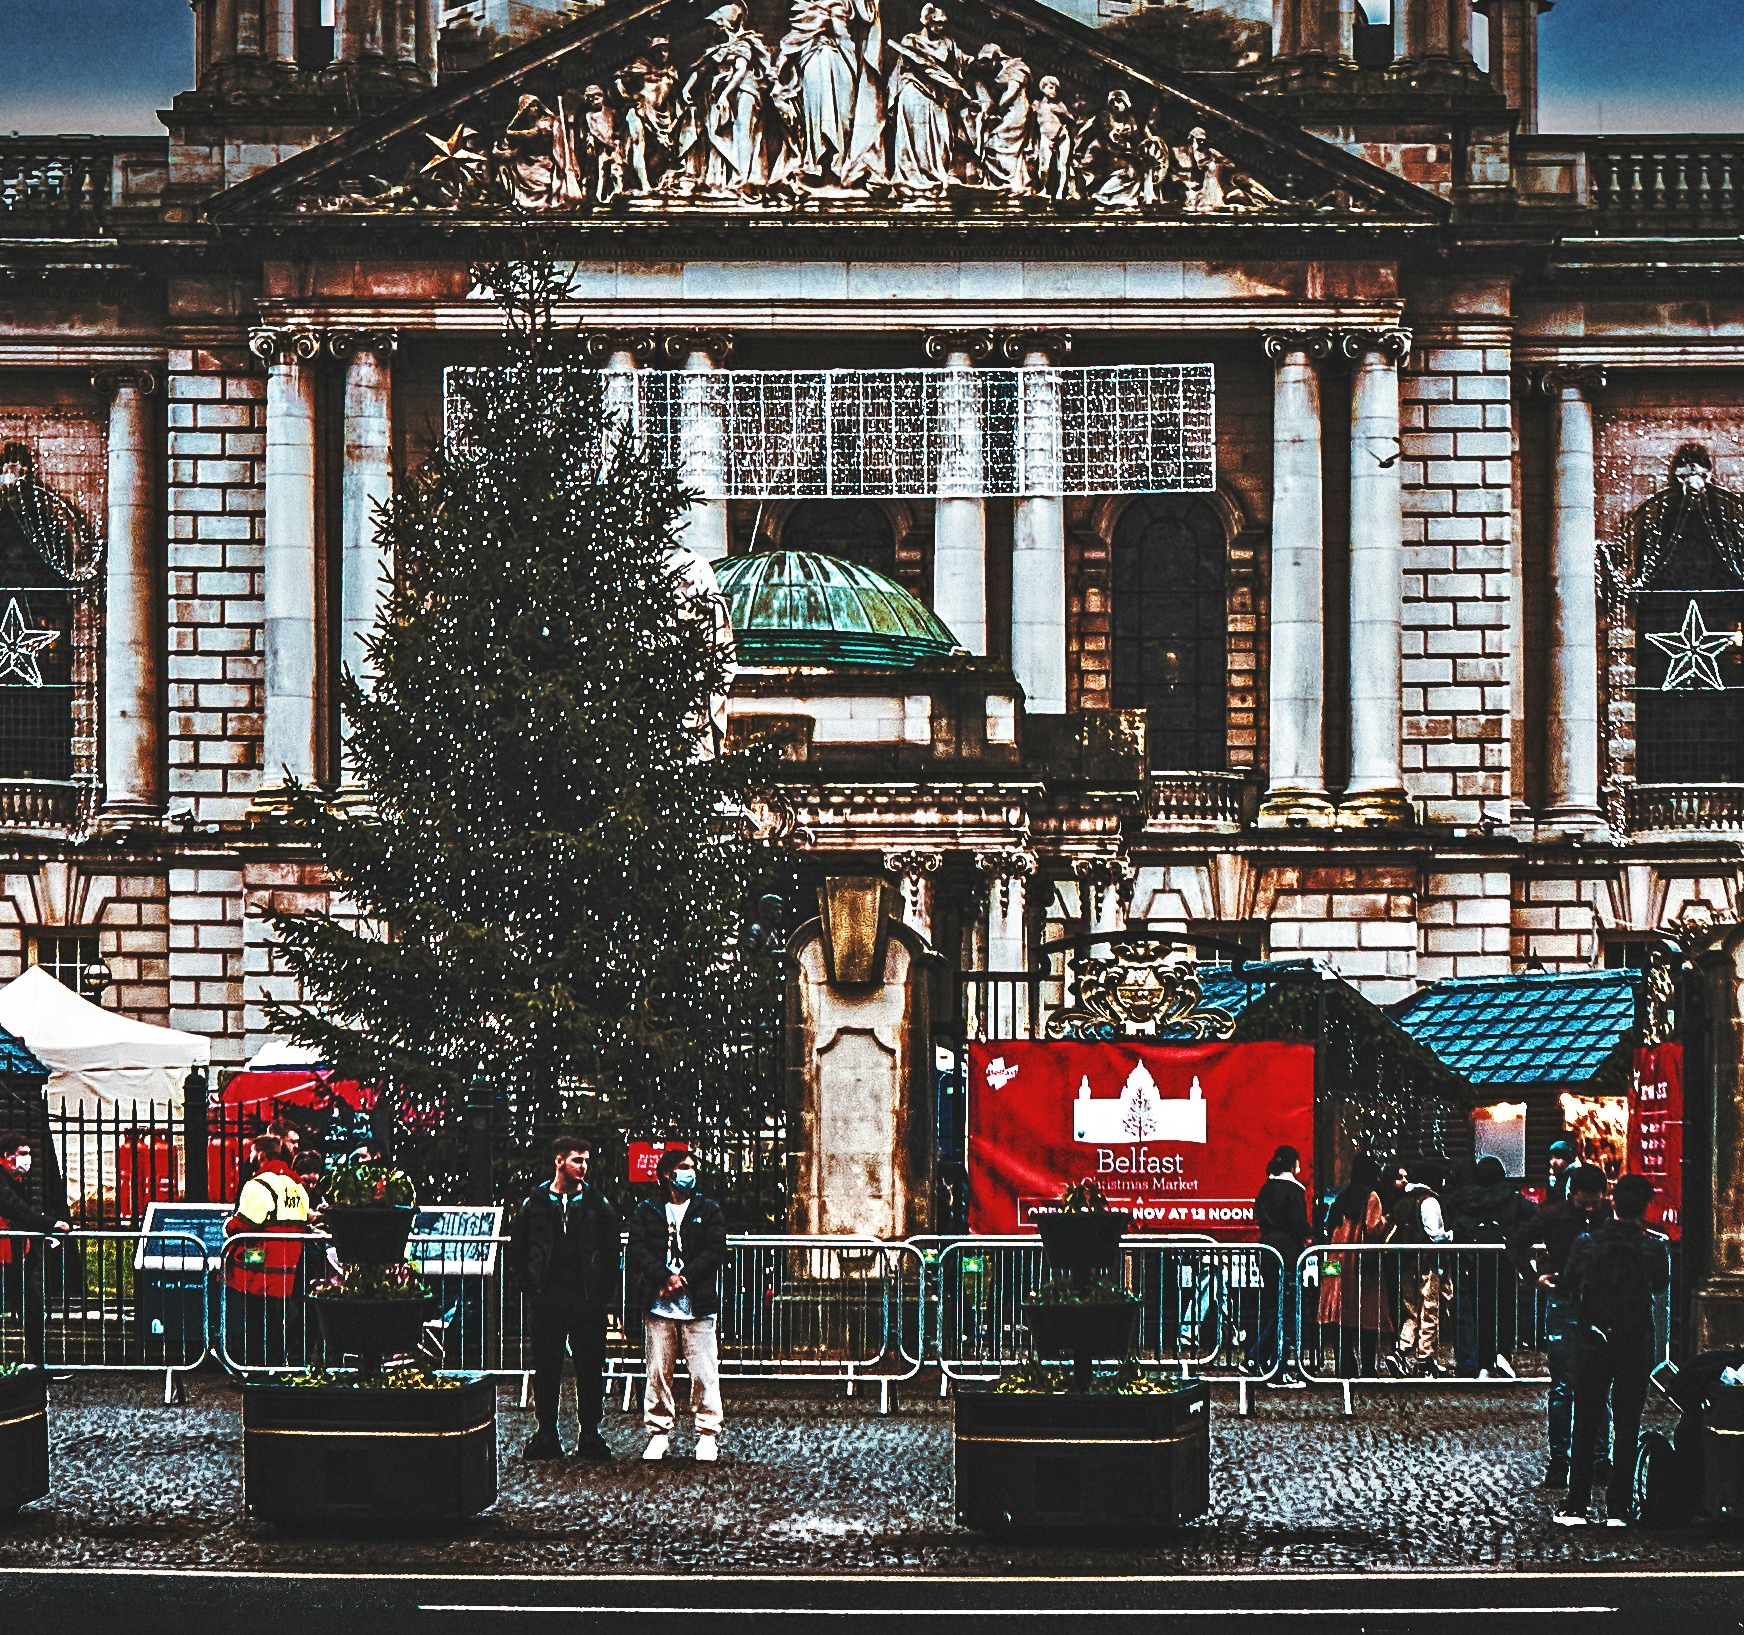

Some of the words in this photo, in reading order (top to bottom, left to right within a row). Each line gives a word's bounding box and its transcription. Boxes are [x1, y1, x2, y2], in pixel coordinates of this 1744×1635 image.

[1097, 1146, 1184, 1174] Belfast
[1152, 1176, 1198, 1191] Market
[1132, 1207, 1166, 1220] NOV
[1168, 1207, 1189, 1220] AT
[1190, 1207, 1206, 1220] 12
[1208, 1207, 1254, 1220] NOON
